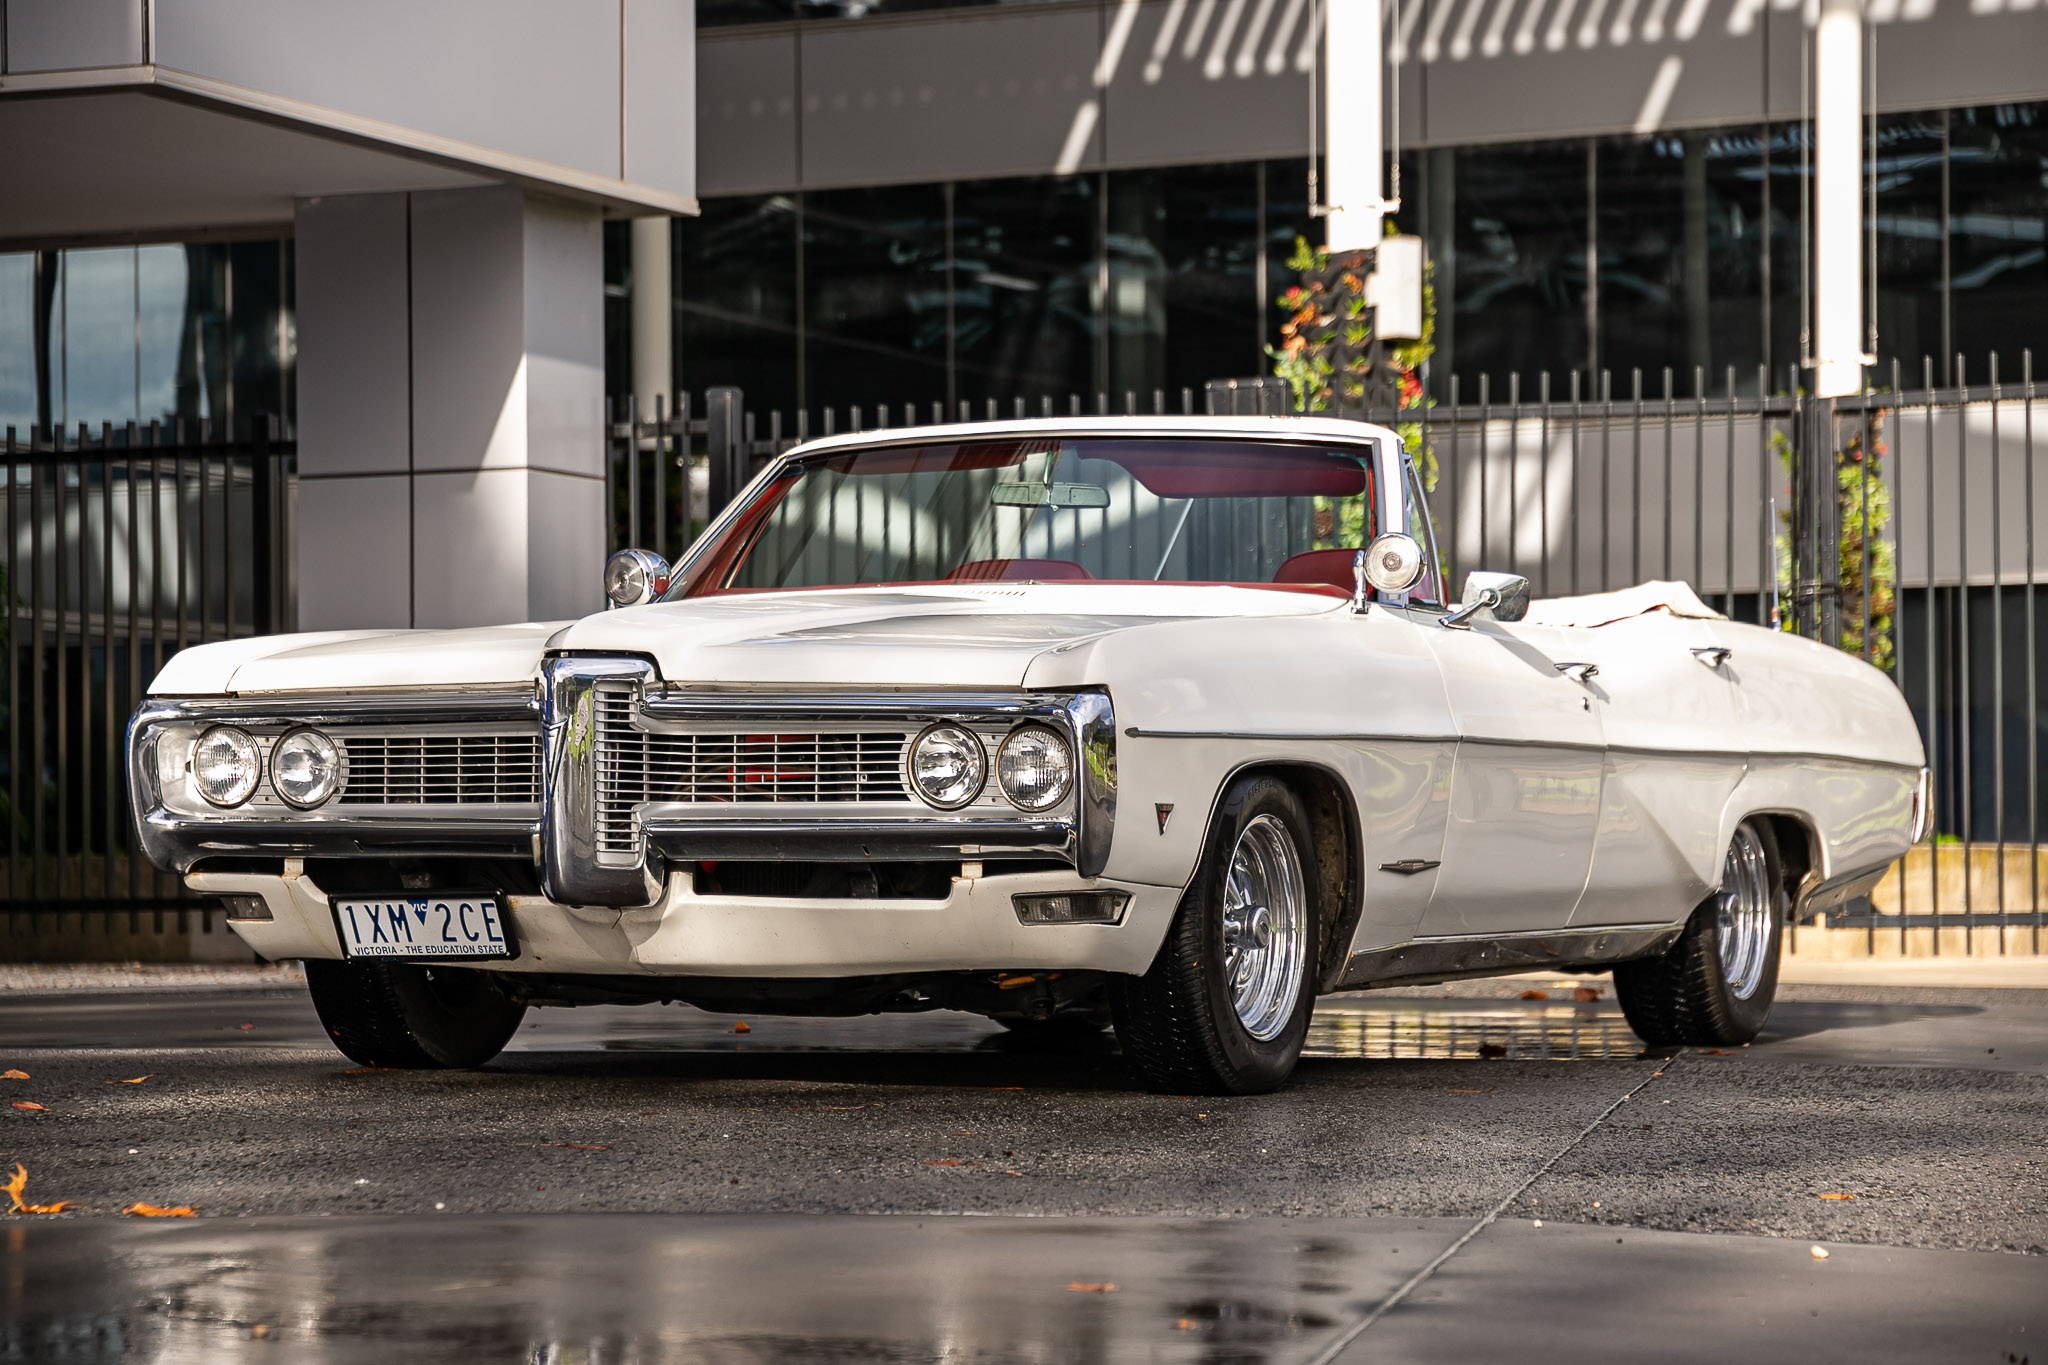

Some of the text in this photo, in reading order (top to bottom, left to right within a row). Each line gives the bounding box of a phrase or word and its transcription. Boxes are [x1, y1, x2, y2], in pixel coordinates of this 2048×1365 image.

[411, 903, 428, 912] VIC
[345, 902, 504, 944] 1XM 2CE
[354, 946, 397, 956] VICTORIA
[405, 945, 424, 954] THE
[425, 945, 476, 954] EDUCATION
[477, 944, 504, 954] STATE
